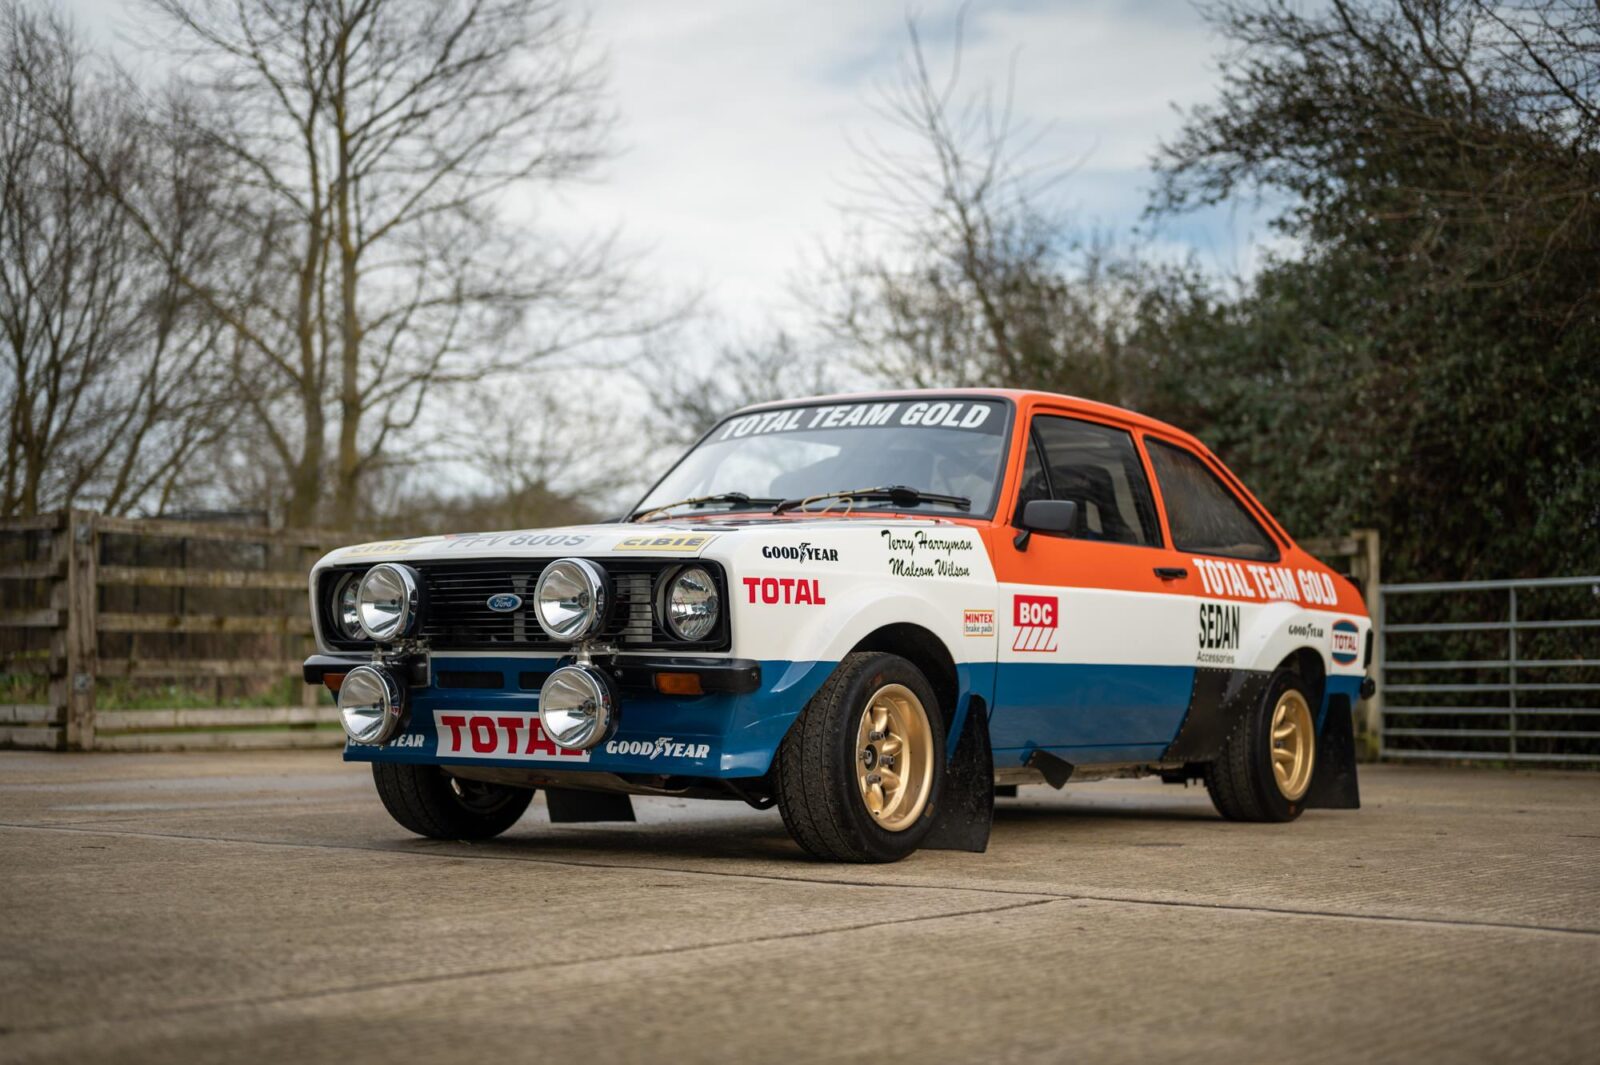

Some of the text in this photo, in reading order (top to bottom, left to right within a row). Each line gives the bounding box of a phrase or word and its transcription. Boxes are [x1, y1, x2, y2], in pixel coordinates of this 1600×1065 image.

[720, 402, 991, 441] TOTAL TEAM GOLD
[509, 534, 591, 547] 800S
[622, 536, 706, 548] CIBIE
[881, 529, 973, 556] Terry Harryman
[889, 558, 970, 577] Malcom Wilson
[742, 576, 826, 606] TOTAL
[1192, 558, 1339, 606] TOTAL TEAM GOLD
[965, 613, 993, 624] MINTEX
[1019, 602, 1053, 625] BOC
[1198, 602, 1241, 650] SEDAN
[1333, 633, 1357, 651] TOTAL
[1196, 650, 1236, 665] Accessories
[441, 715, 585, 757] TOTA
